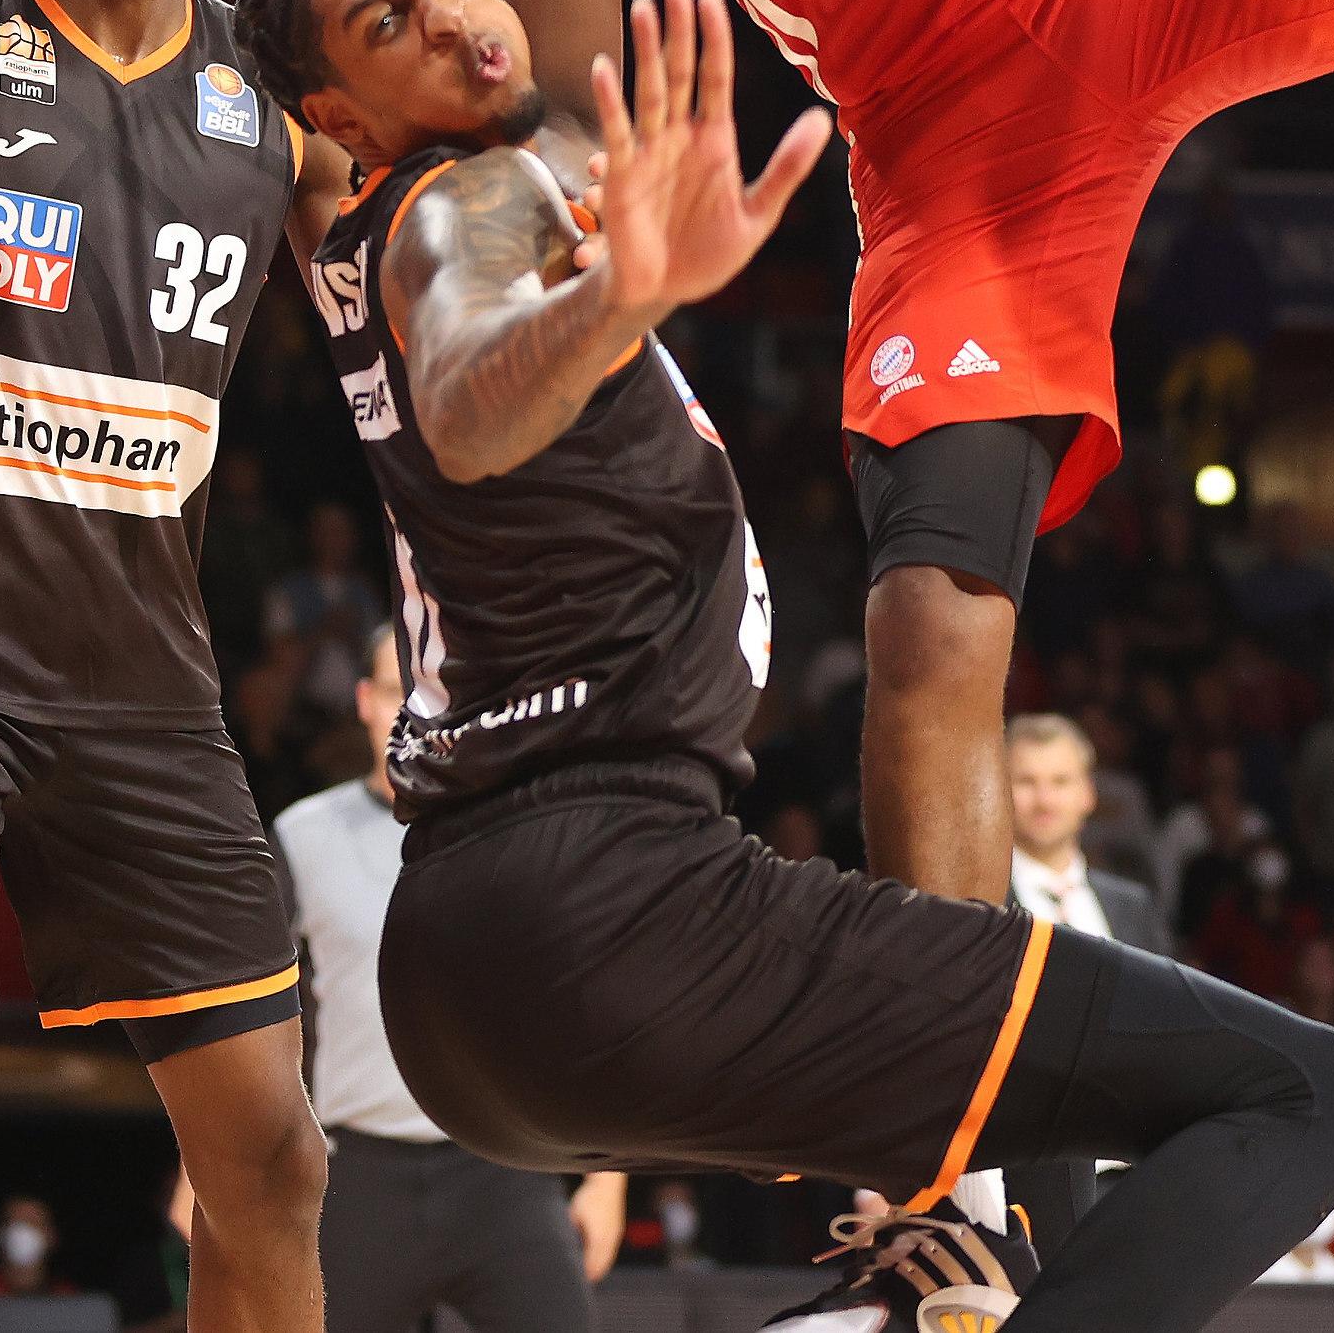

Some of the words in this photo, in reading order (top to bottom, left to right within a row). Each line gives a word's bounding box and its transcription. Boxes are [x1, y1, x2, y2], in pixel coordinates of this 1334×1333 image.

[10, 80, 43, 99] ulm
[205, 111, 251, 138] BBL
[148, 222, 249, 347] 32
